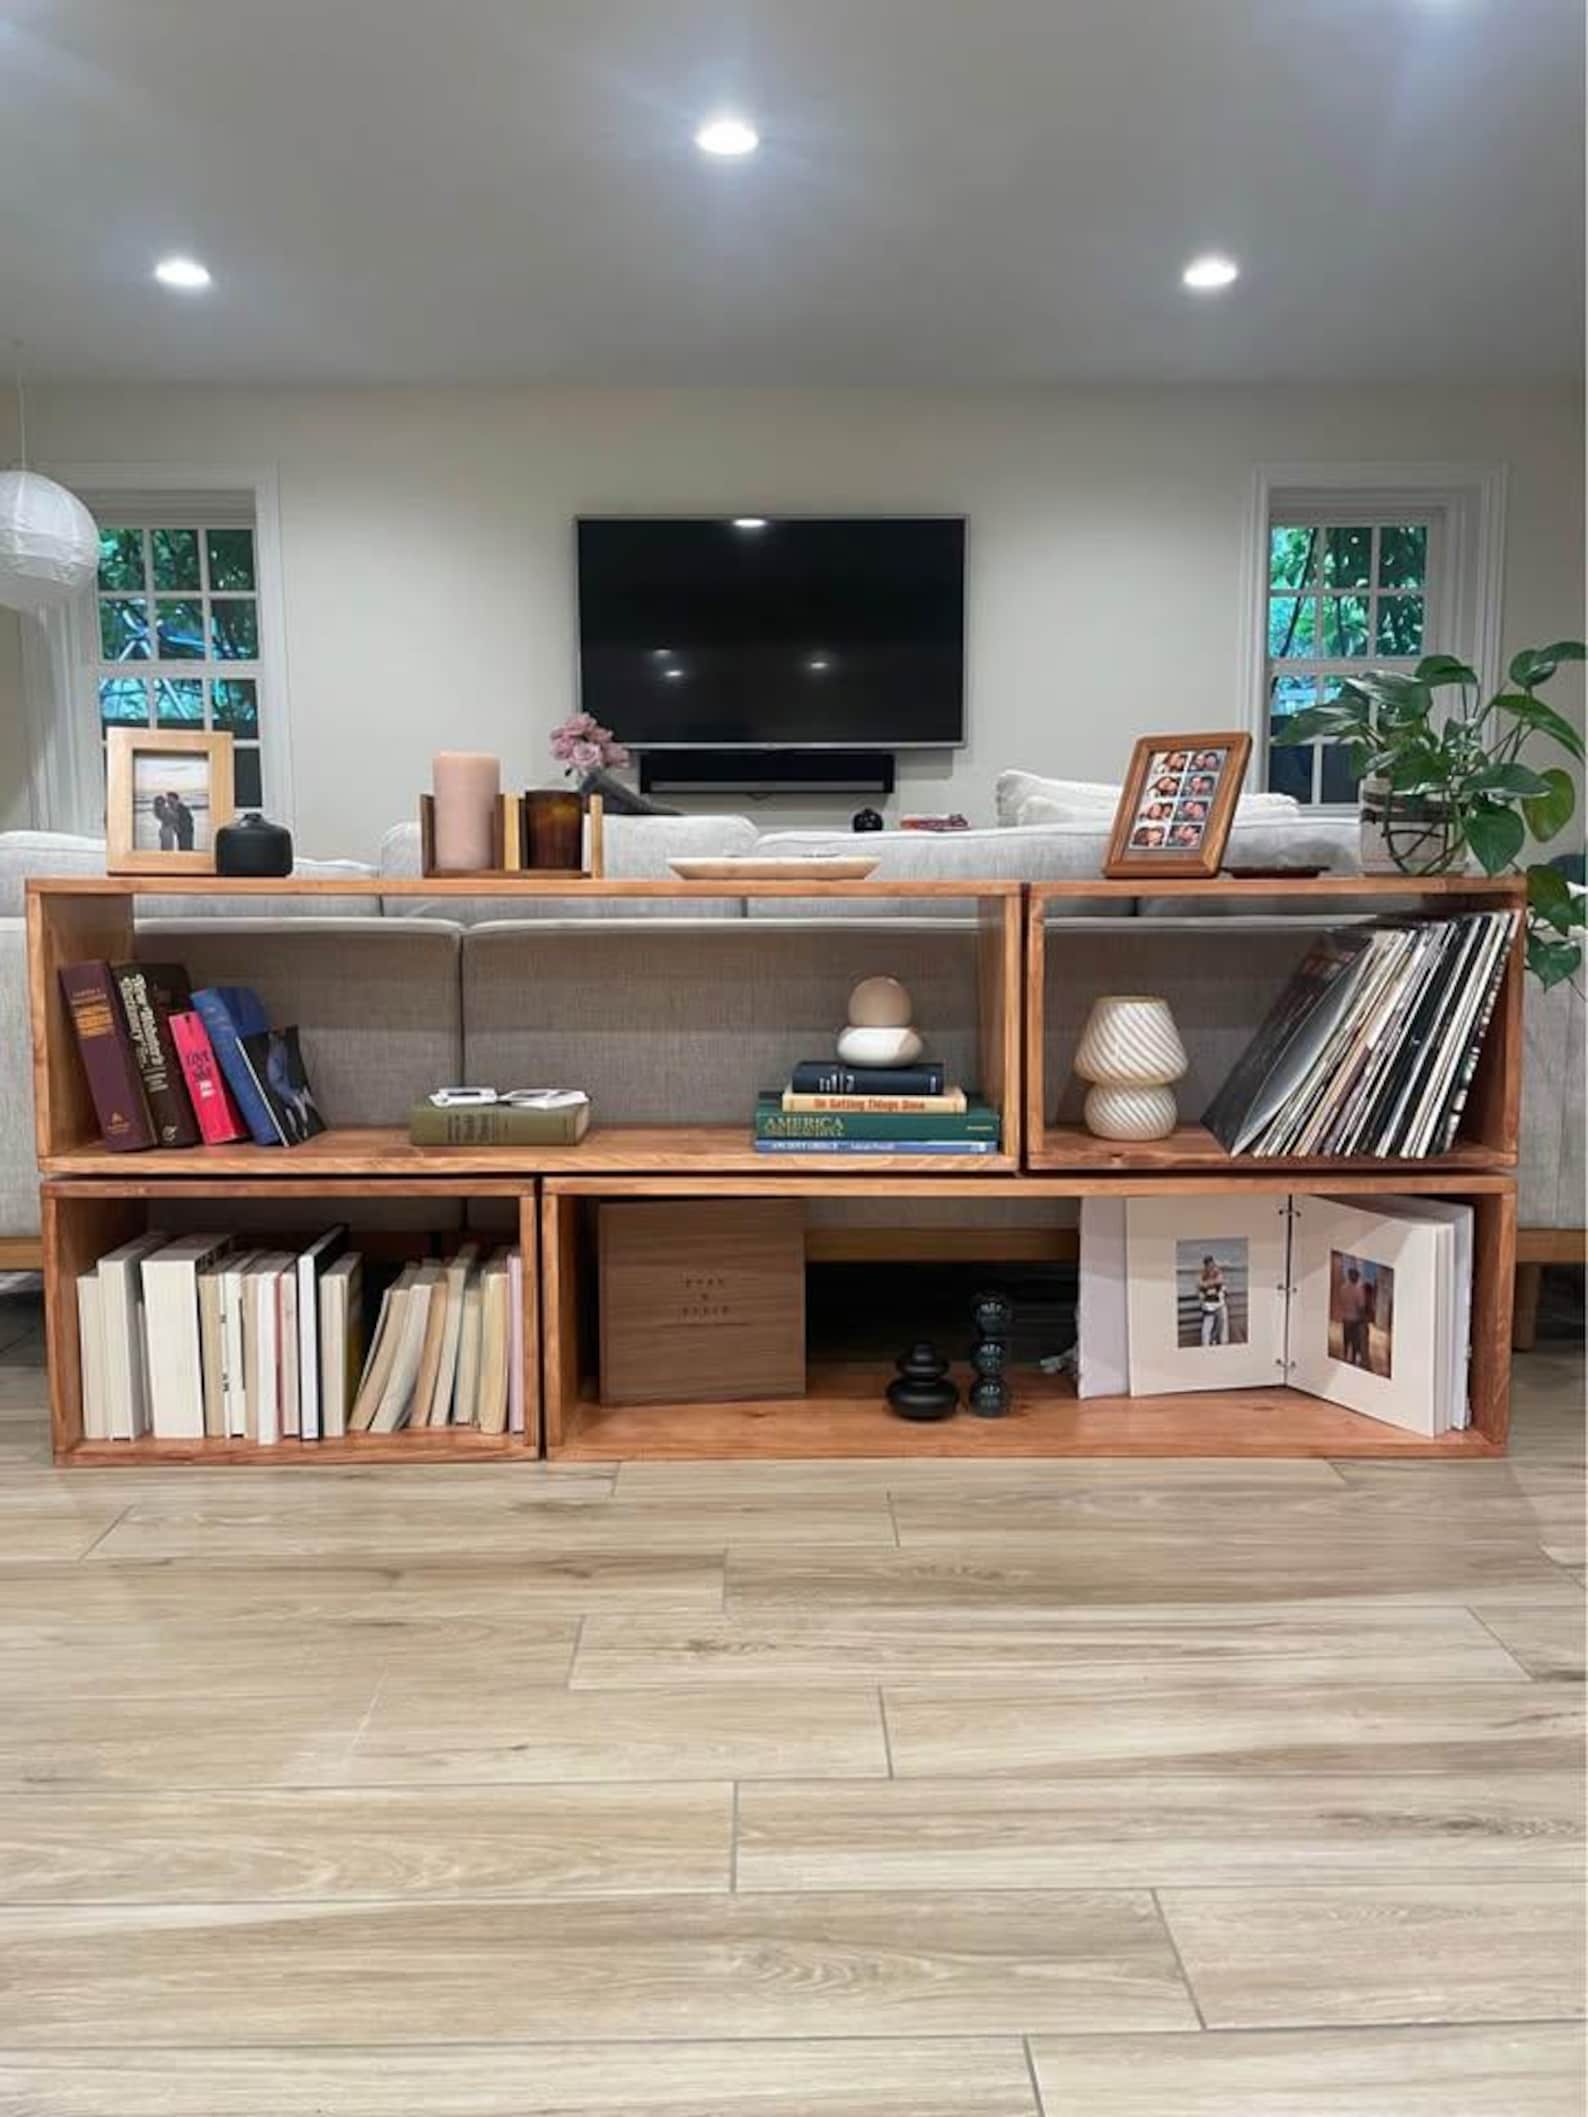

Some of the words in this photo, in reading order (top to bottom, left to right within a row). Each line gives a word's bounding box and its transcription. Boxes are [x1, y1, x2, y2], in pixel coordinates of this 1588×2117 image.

[829, 1098, 865, 1112] Getting
[868, 1098, 899, 1112] Things
[902, 1099, 925, 1110] Done
[764, 1116, 845, 1131] AMERICA
